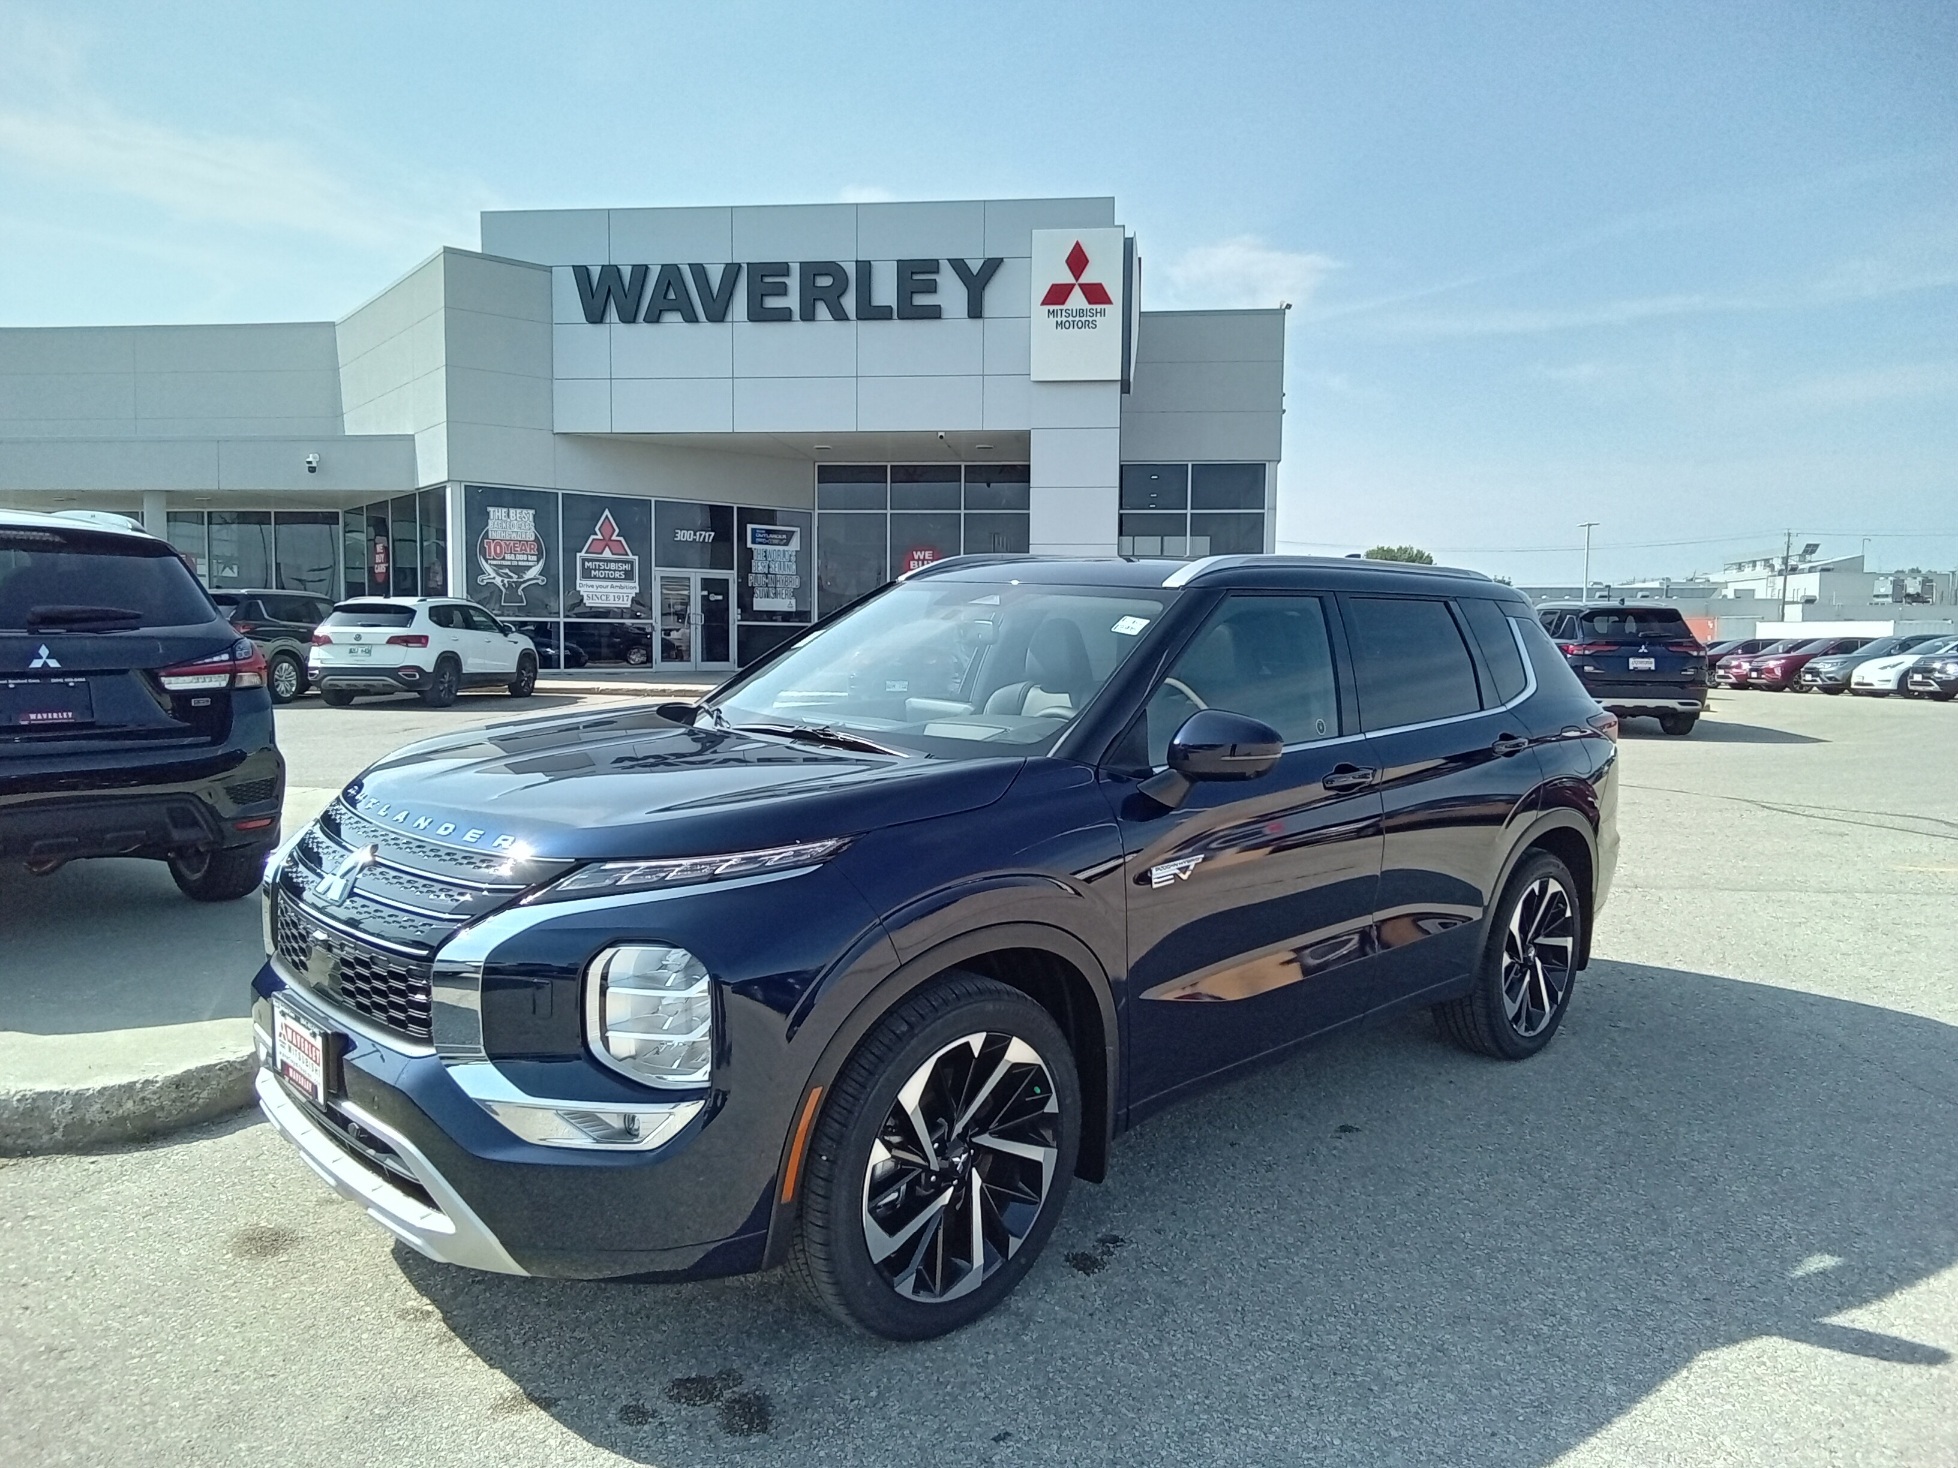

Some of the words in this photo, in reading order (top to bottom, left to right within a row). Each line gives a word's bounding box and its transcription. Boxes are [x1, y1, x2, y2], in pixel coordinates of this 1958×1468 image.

[572, 258, 1004, 324] WAVERLEY
[1047, 308, 1106, 318] MITSUBISHI
[1055, 320, 1098, 330] MOTORS
[488, 507, 508, 520] THE
[509, 508, 535, 521] BEST
[674, 529, 715, 542] 300-1717
[484, 540, 504, 559] 10
[503, 541, 538, 554] YEAR
[912, 551, 933, 560] WE
[584, 560, 631, 570] MITSUBISHI
[752, 560, 769, 573] BEST
[591, 570, 625, 578] MOTORS
[776, 575, 800, 588] HYBRID
[29, 711, 73, 720] WAVERLEY
[1151, 863, 1196, 889] EV
[286, 1026, 320, 1064] WAVERLEY
